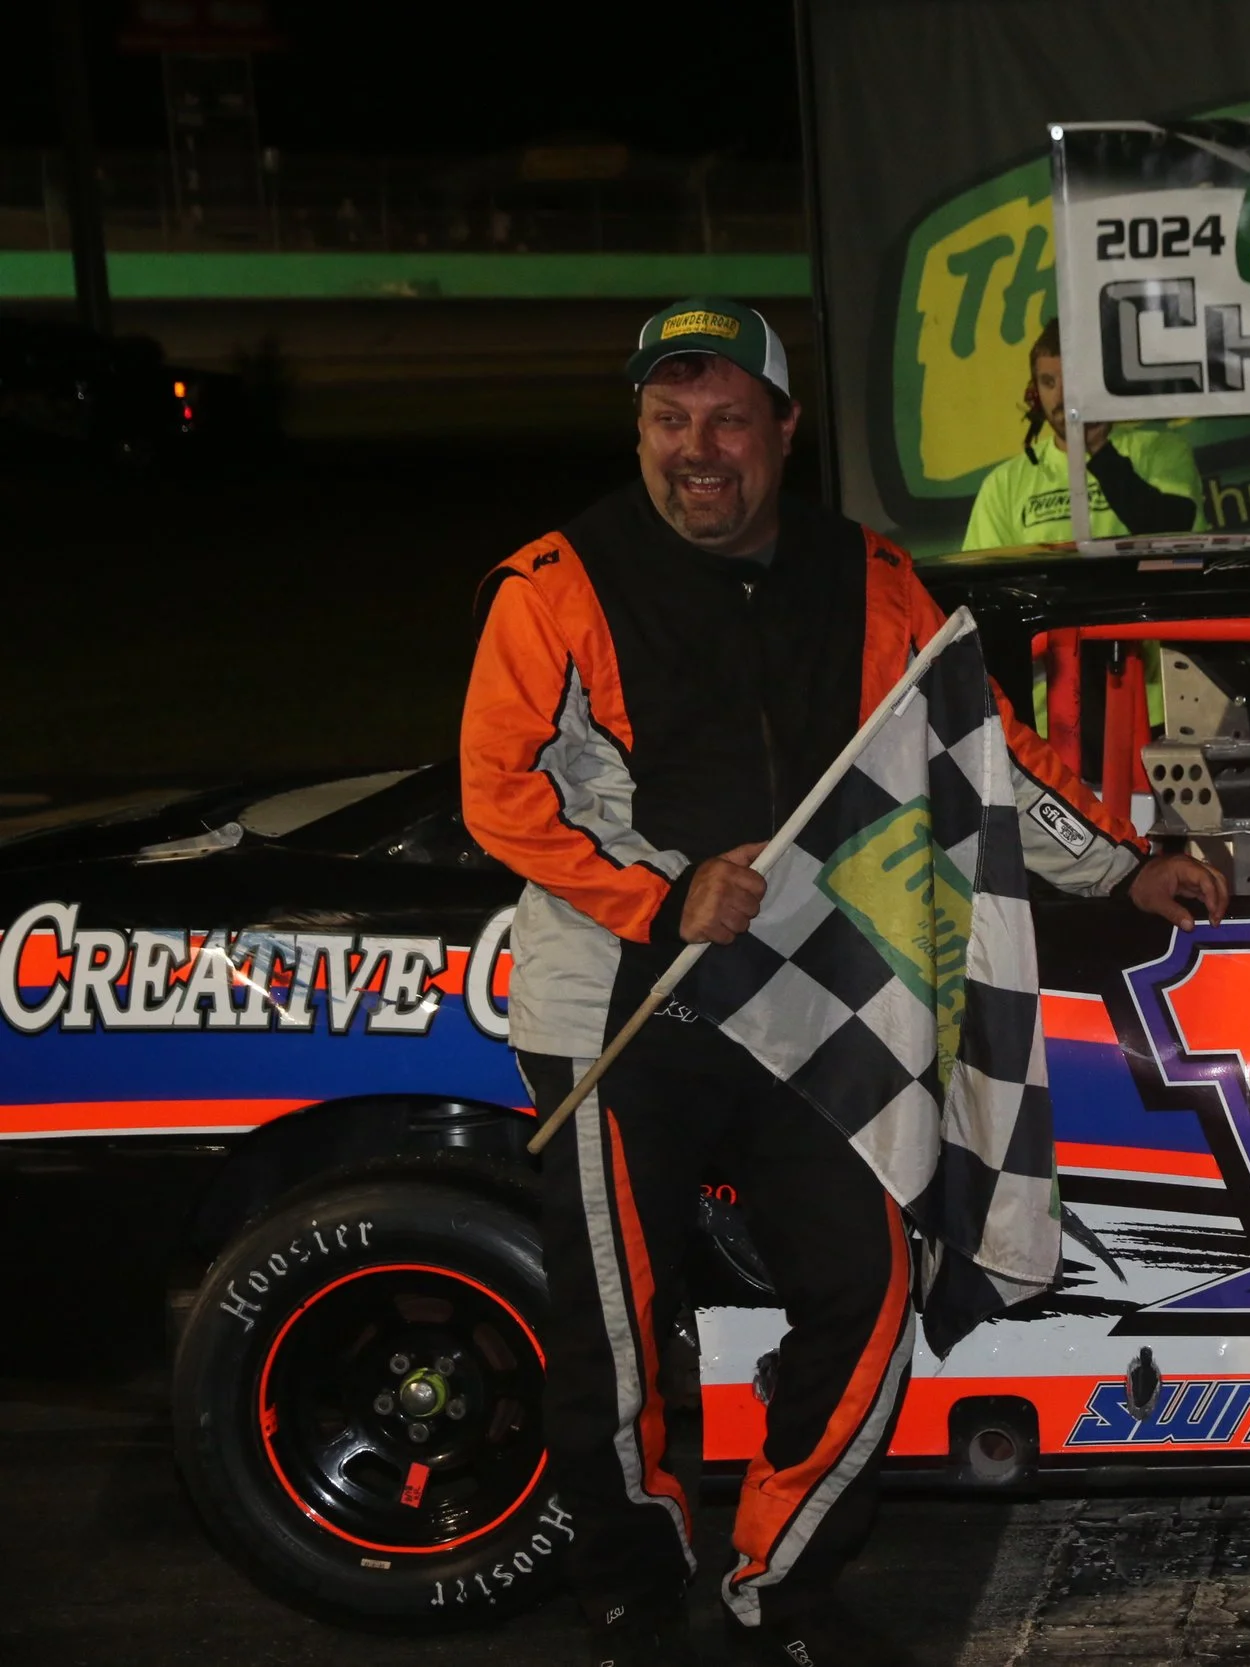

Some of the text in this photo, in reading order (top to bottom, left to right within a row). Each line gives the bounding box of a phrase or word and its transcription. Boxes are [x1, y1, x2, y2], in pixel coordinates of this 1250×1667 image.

[1096, 215, 1226, 261] 2024
[664, 313, 710, 340] THUNDER
[710, 315, 738, 341] ROAD
[1041, 805, 1061, 825] sfi
[0, 902, 446, 1037] CREATIVE
[220, 1219, 374, 1335] Hoosier
[430, 1491, 575, 1607] Hoosier
